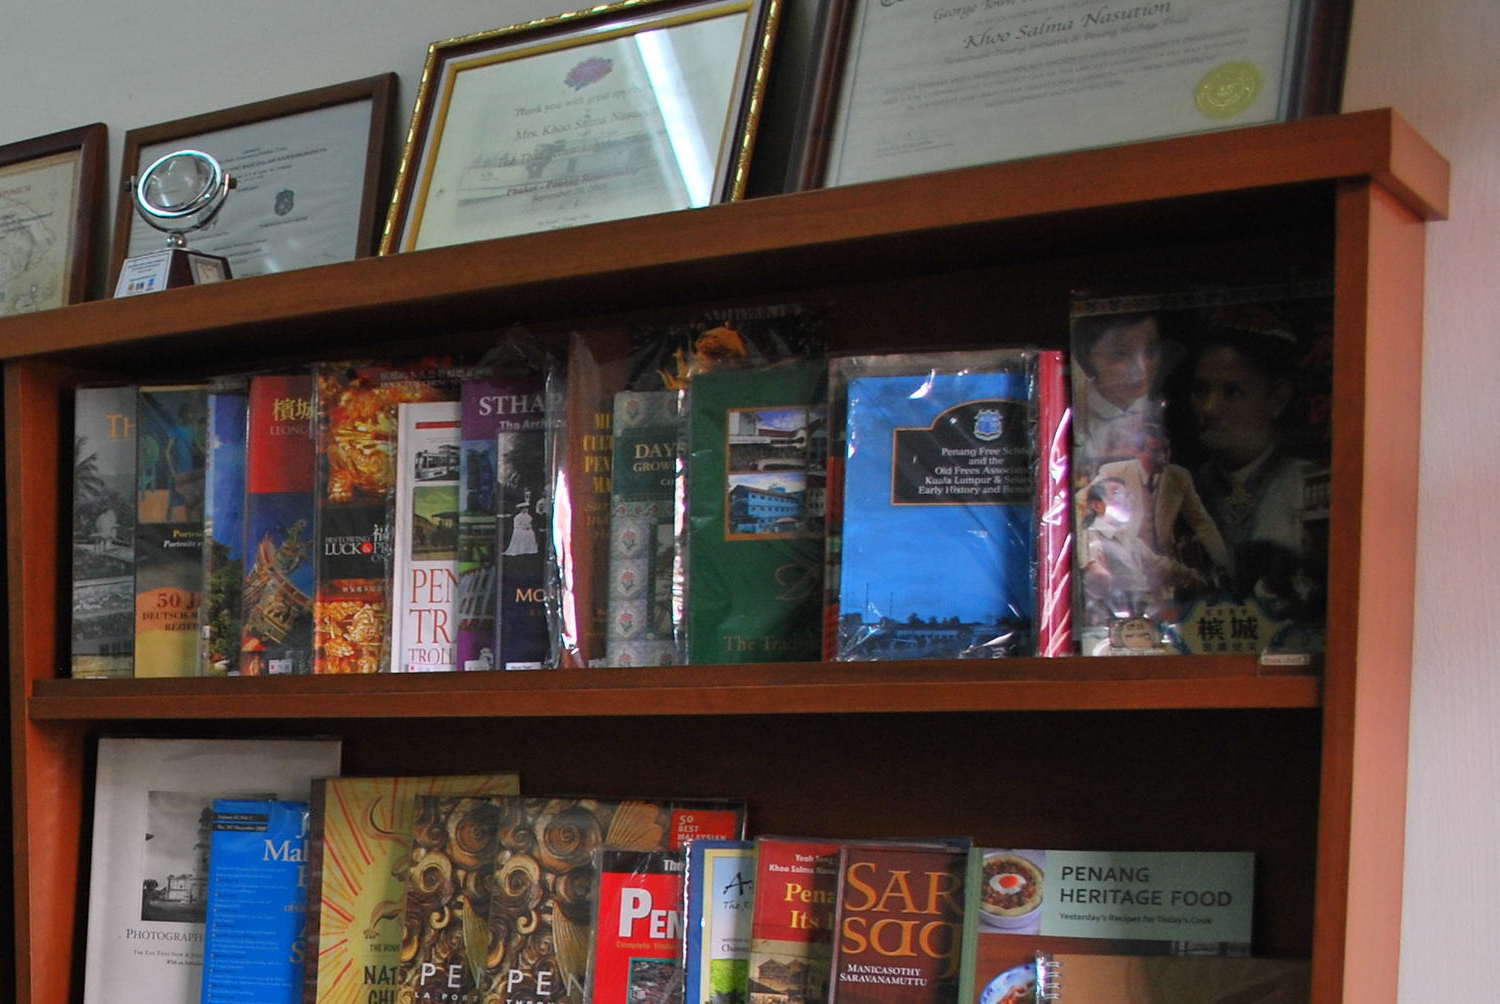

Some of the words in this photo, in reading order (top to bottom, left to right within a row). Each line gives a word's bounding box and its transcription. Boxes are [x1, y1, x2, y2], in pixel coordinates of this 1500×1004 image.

[1015, 16, 1074, 41] Salma
[1080, 1, 1172, 30] Nasution
[941, 447, 978, 458] Penang
[979, 447, 1000, 457] Free
[969, 457, 986, 466] and
[988, 457, 1005, 466] the
[934, 466, 952, 476] Old
[925, 476, 952, 486] Kuala
[954, 476, 992, 487] Lumpur
[918, 486, 944, 497] Early
[325, 543, 361, 556] LUCK
[795, 854, 814, 864] Yeoh
[769, 864, 789, 873] Khoo
[790, 865, 815, 874] Salma
[1061, 865, 1150, 884] PENANG
[1059, 888, 1162, 906] HERITAGE
[1170, 890, 1232, 908] FOOD
[790, 910, 820, 931] Its
[847, 963, 922, 978] MANICASOTHY
[838, 972, 929, 988] SARAVANAMUTTU
